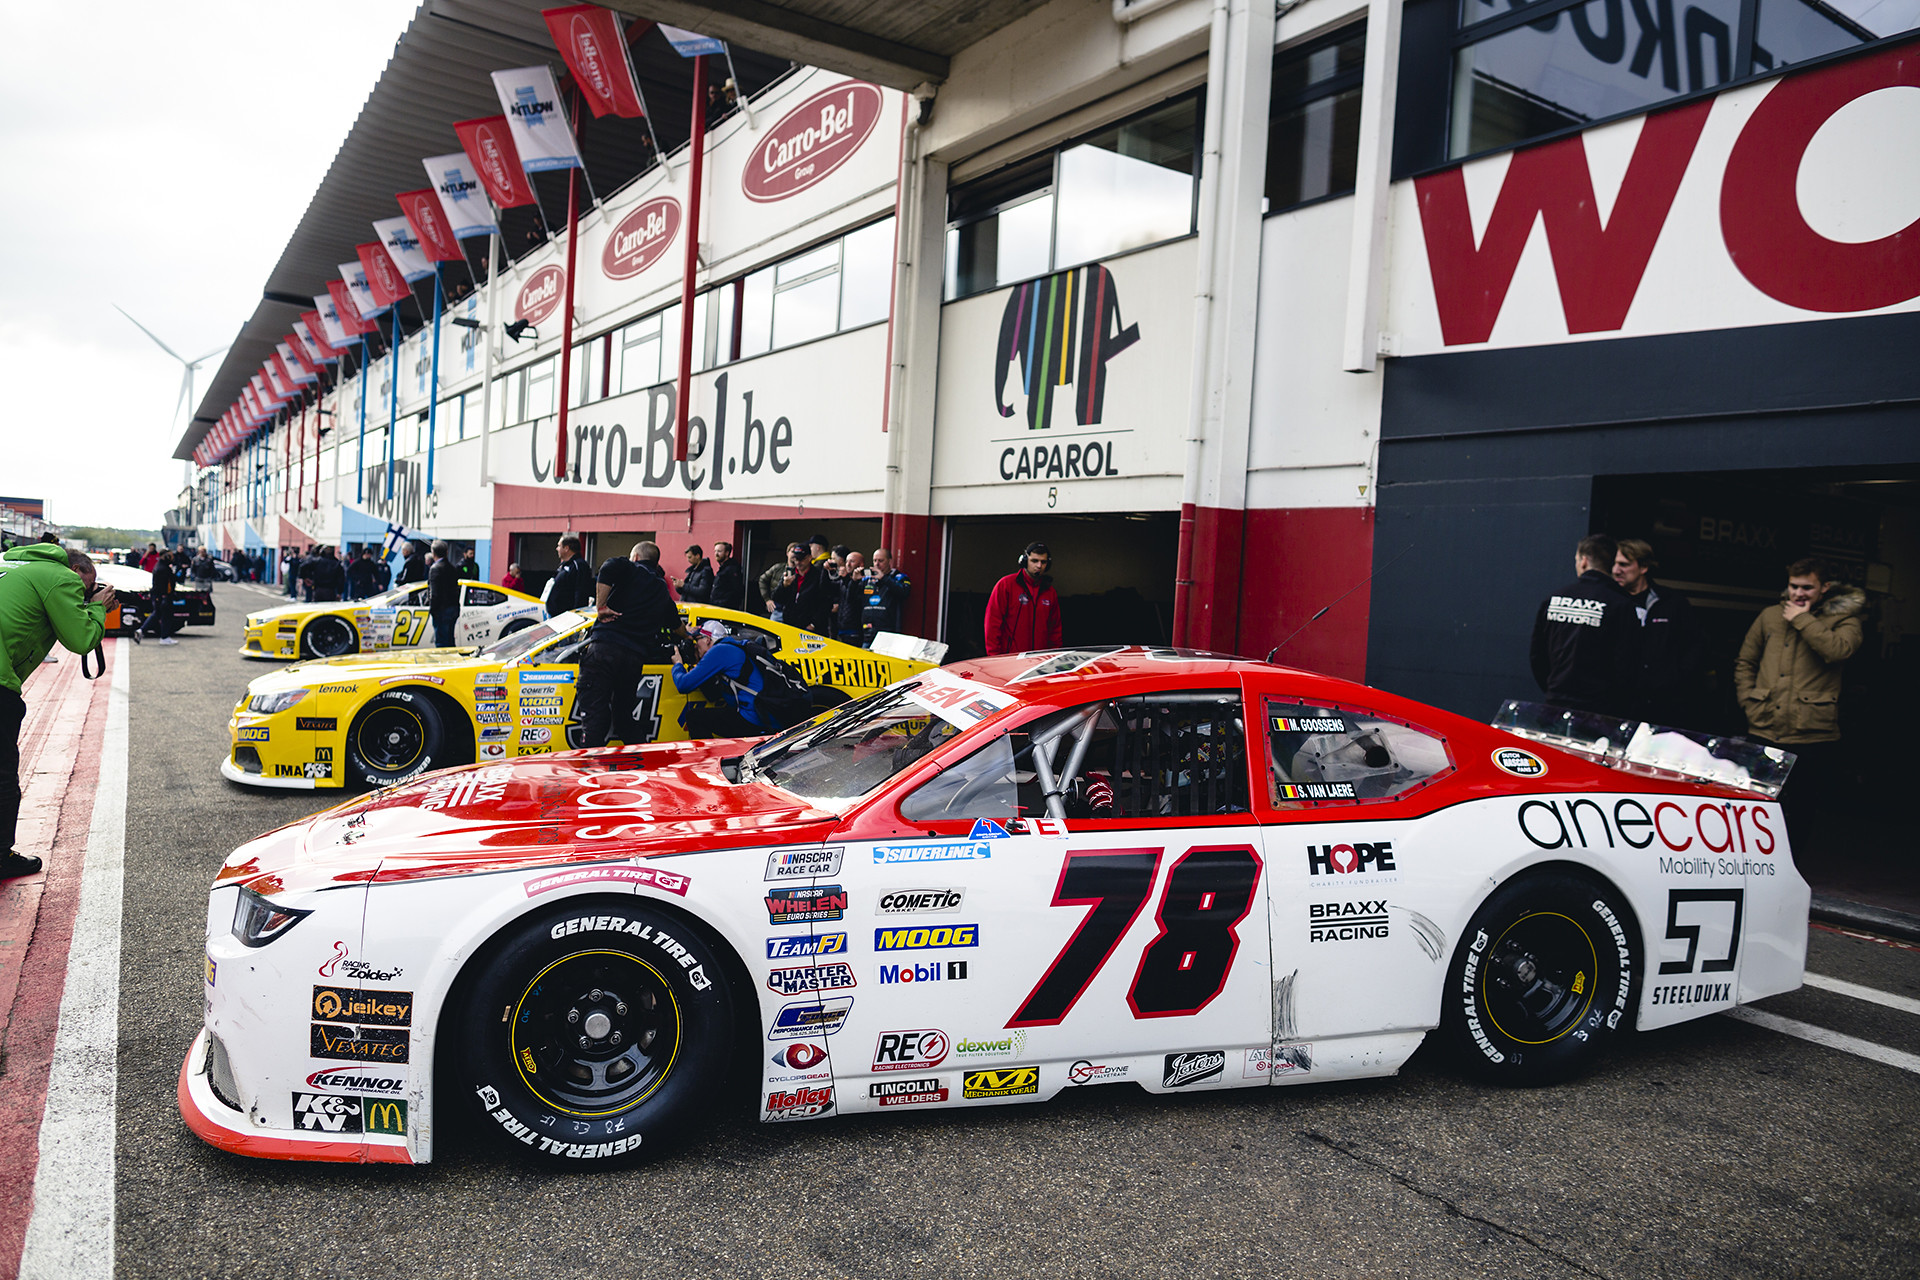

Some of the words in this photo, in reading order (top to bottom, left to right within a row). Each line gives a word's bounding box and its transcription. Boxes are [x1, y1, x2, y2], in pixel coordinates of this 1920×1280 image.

[763, 91, 855, 173] Carro-Bel
[794, 163, 815, 180] Group
[613, 206, 667, 258] Carro-Bel
[521, 273, 558, 308] Carro-Bel
[1000, 441, 1118, 480] CAPAROL
[1047, 486, 1058, 509] 5
[1550, 596, 1607, 611] BRAXX
[391, 609, 430, 646] 27
[1547, 611, 1601, 627] MOTORS
[520, 696, 561, 706] MOOG
[522, 707, 547, 715] Mobil
[1290, 717, 1300, 731] M.
[1300, 718, 1344, 732] GOOSSENS
[238, 728, 269, 740] MOOG
[275, 764, 303, 777] IMA
[1298, 785, 1307, 798] S.
[1309, 785, 1326, 798] VAN
[1327, 783, 1355, 797] LAERE
[1518, 798, 1776, 855] anecars
[791, 852, 833, 864] NASCAR
[1307, 842, 1396, 875] HOPE
[777, 865, 806, 875] RACE
[808, 864, 830, 873] CAR
[1659, 857, 1715, 878] Mobility
[1719, 857, 1775, 876] Solutions
[527, 869, 611, 893] GENERAL
[613, 869, 655, 881] TIRE
[1310, 880, 1345, 888] CHARITY
[1349, 877, 1398, 885] FUNDRAISER
[765, 892, 847, 914] WHELEN
[880, 891, 962, 910] COMETIC
[1310, 900, 1388, 917] BRAXX
[786, 912, 805, 921] EURO
[551, 915, 652, 940] GENERAL
[650, 931, 697, 969] TIRE
[878, 926, 976, 950] MOOG
[1003, 844, 1264, 1029] 78
[1310, 926, 1389, 942] RACING
[1592, 899, 1631, 968] GENERAL
[1615, 969, 1631, 1010] TIRE
[341, 960, 371, 969] RACING
[879, 962, 941, 984] Mobil
[1462, 951, 1480, 993] TIRE
[346, 967, 397, 981] Zolder
[769, 965, 848, 987] QUARTER
[783, 975, 852, 993] MASTER
[342, 997, 409, 1019] jeikey
[773, 1024, 813, 1035] PERFORMANCE
[1463, 995, 1505, 1064] GENERAL
[956, 1037, 1013, 1053] dexwet
[895, 1062, 930, 1070] ELECTRONICS
[312, 1073, 405, 1091] KENNOL
[768, 1073, 830, 1083] CYCLOPSGEAR
[344, 1086, 389, 1095] PERFORMANCE
[873, 1080, 936, 1096] LINCOLN
[964, 1089, 1009, 1099] MECHANIX
[1010, 1085, 1037, 1095] WEAR
[766, 1087, 832, 1111] Holley
[886, 1093, 942, 1105] WELDERS
[765, 1104, 821, 1122] MSD
[491, 1107, 540, 1145] TIRE
[606, 1117, 626, 1134] 78
[538, 1133, 643, 1159] GENERAL
